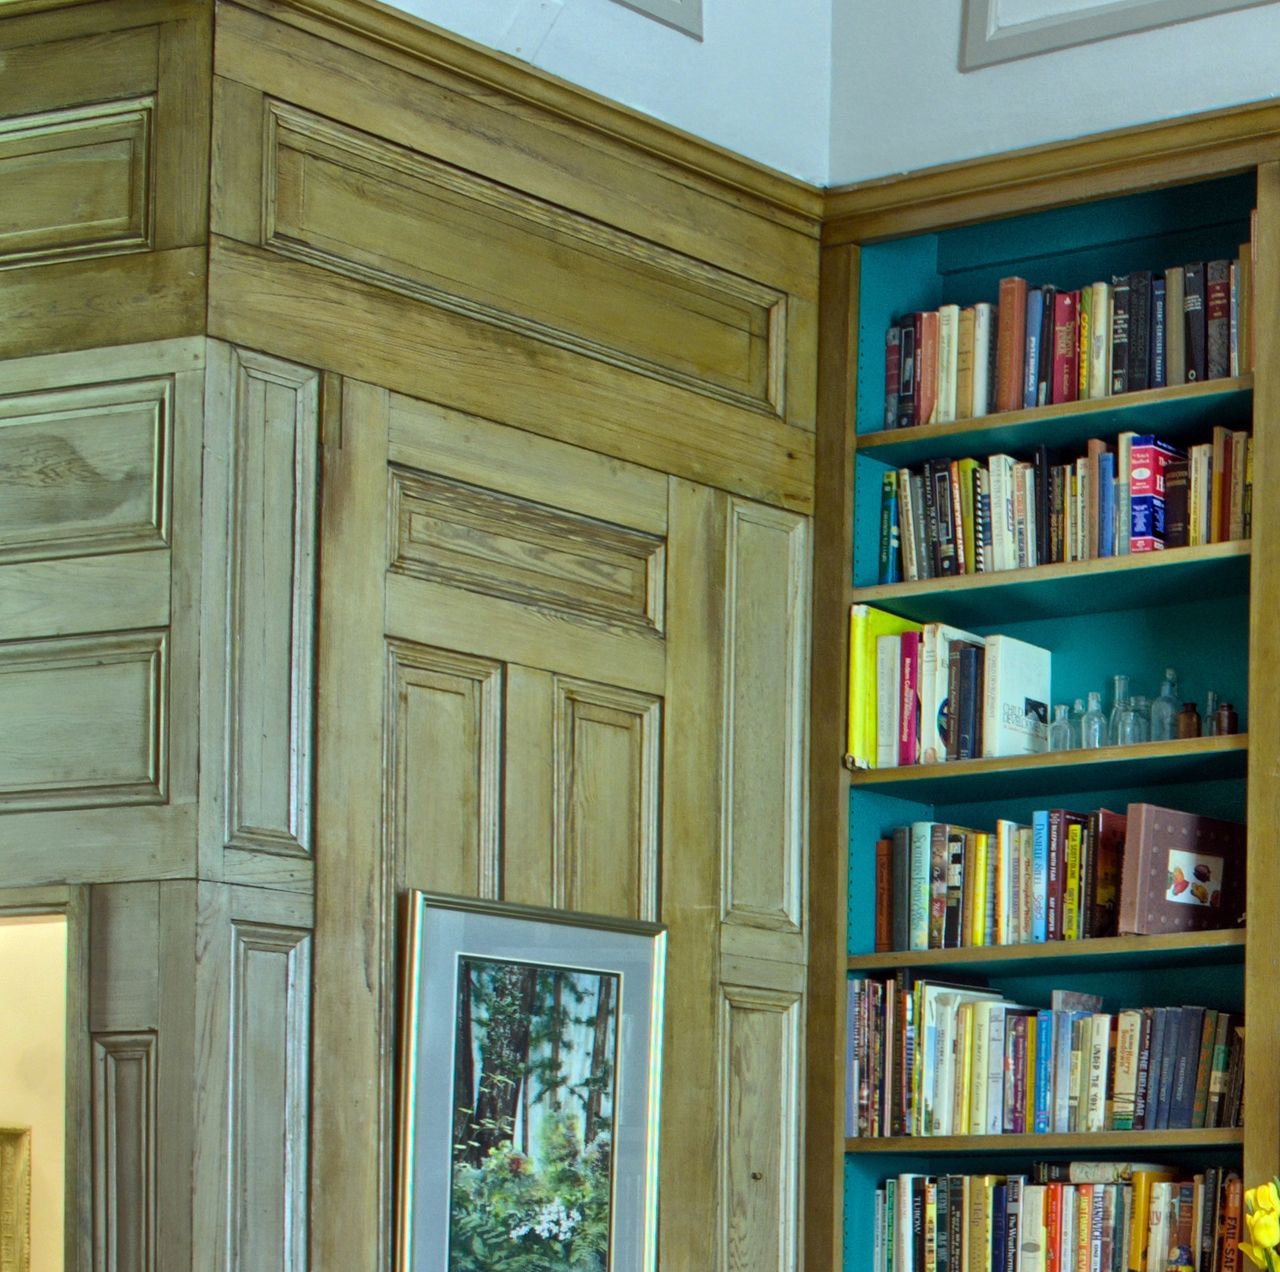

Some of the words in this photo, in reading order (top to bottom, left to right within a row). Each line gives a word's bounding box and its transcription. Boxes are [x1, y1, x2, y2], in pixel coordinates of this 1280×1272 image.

[1035, 824, 1045, 859] DANIELLE
[1092, 1044, 1102, 1070] UNDER
[1140, 1052, 1149, 1070] THE
[1091, 1076, 1100, 1088] THE
[1138, 1072, 1147, 1097] BELL
[1090, 1092, 1098, 1112] YOKE
[1136, 1099, 1146, 1116] JAR
